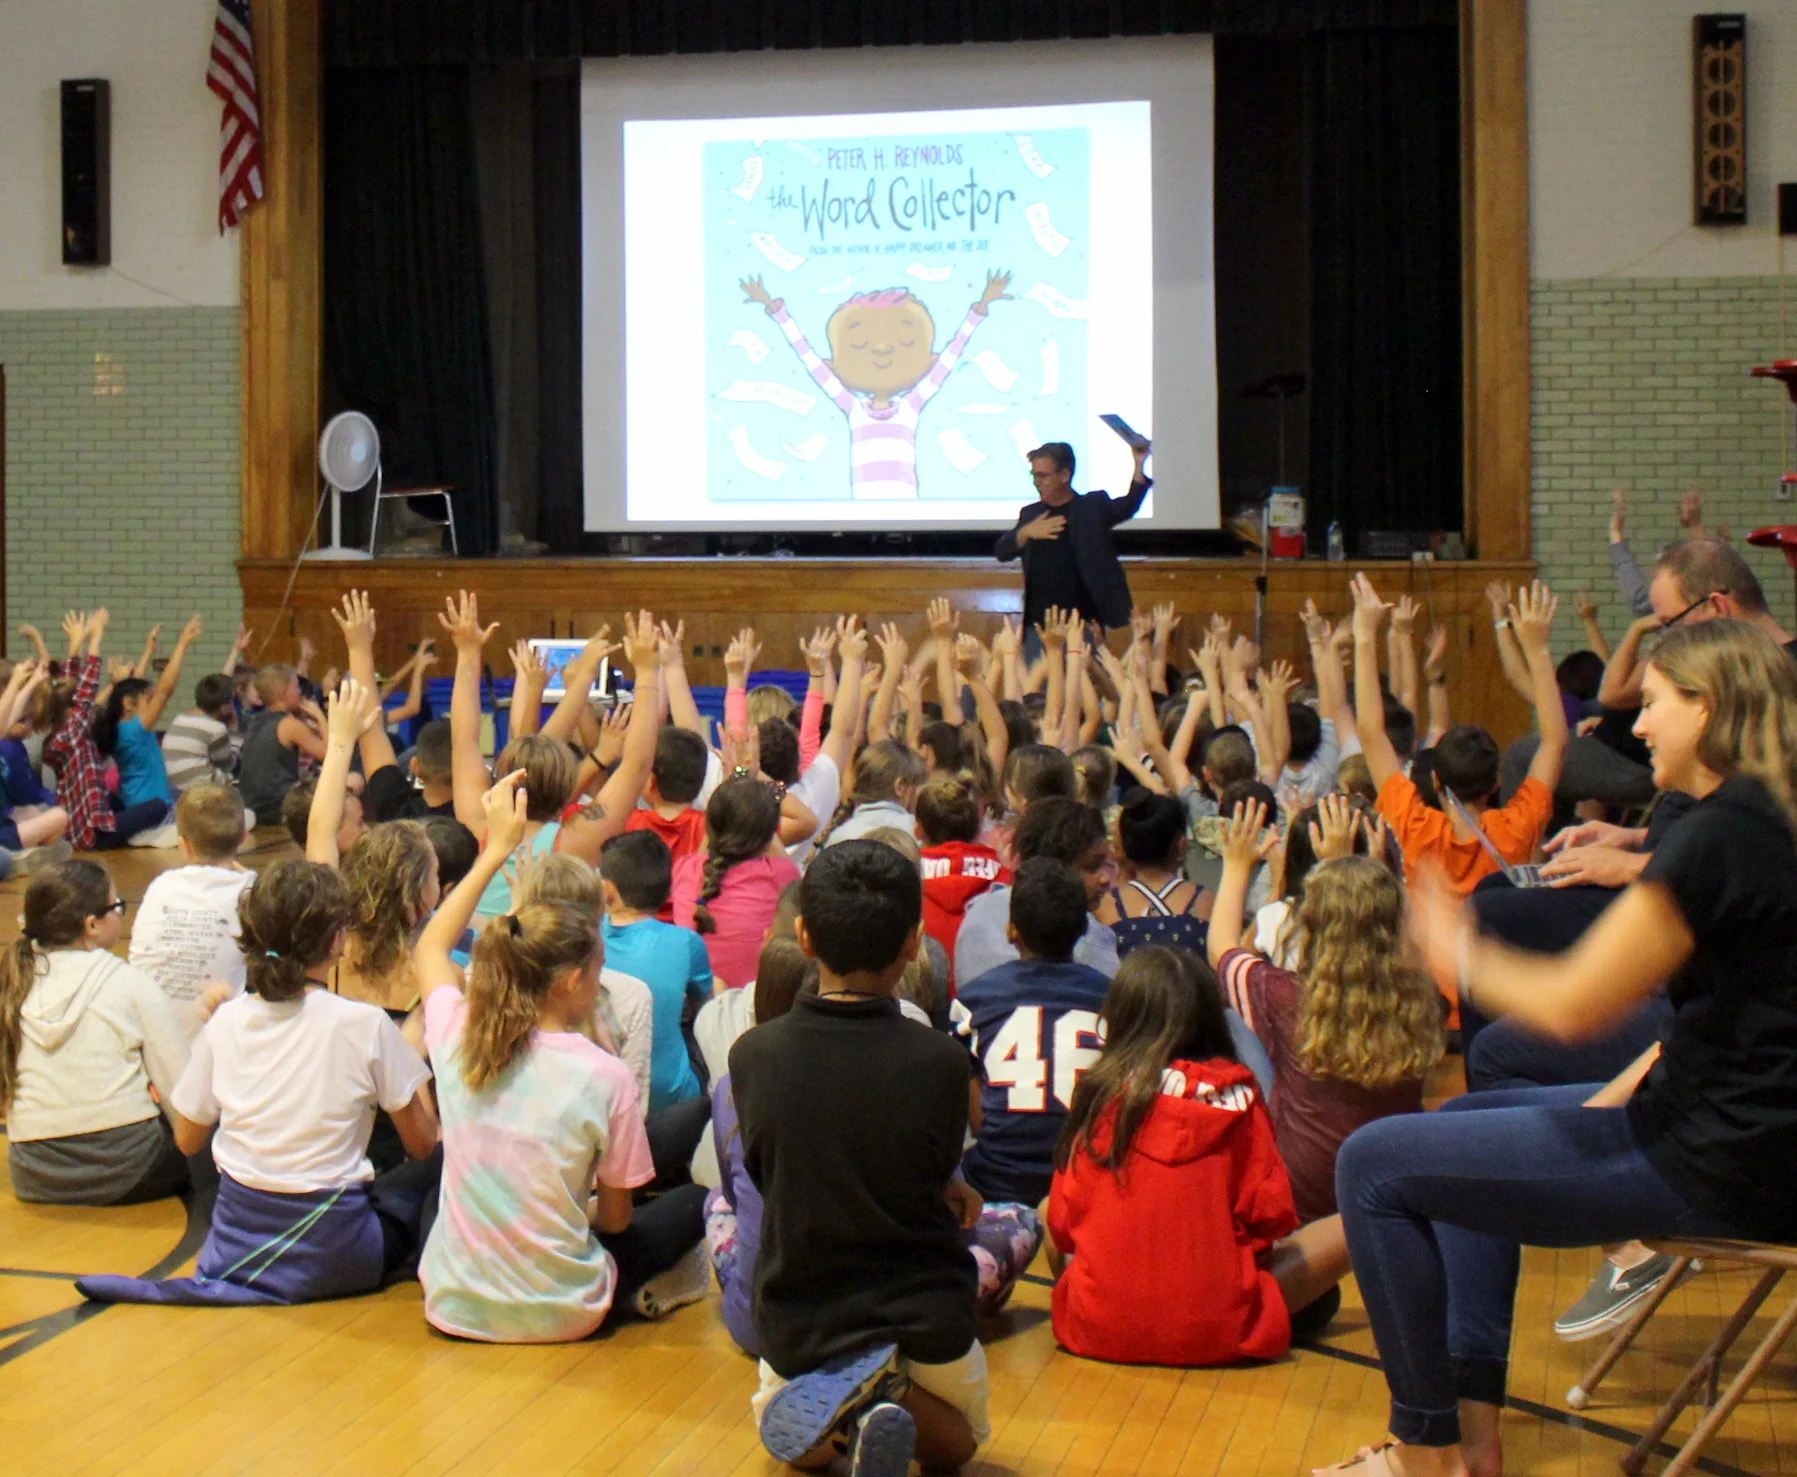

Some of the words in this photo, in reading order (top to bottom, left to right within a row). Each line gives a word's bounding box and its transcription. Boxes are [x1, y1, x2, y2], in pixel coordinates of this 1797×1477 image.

[827, 147, 867, 170] PETER
[873, 146, 888, 170] H.
[894, 143, 964, 168] REYNOLDS
[765, 184, 799, 209] the
[801, 177, 880, 240] Word
[888, 166, 1016, 233] Collector
[982, 1004, 1110, 1113] 46
